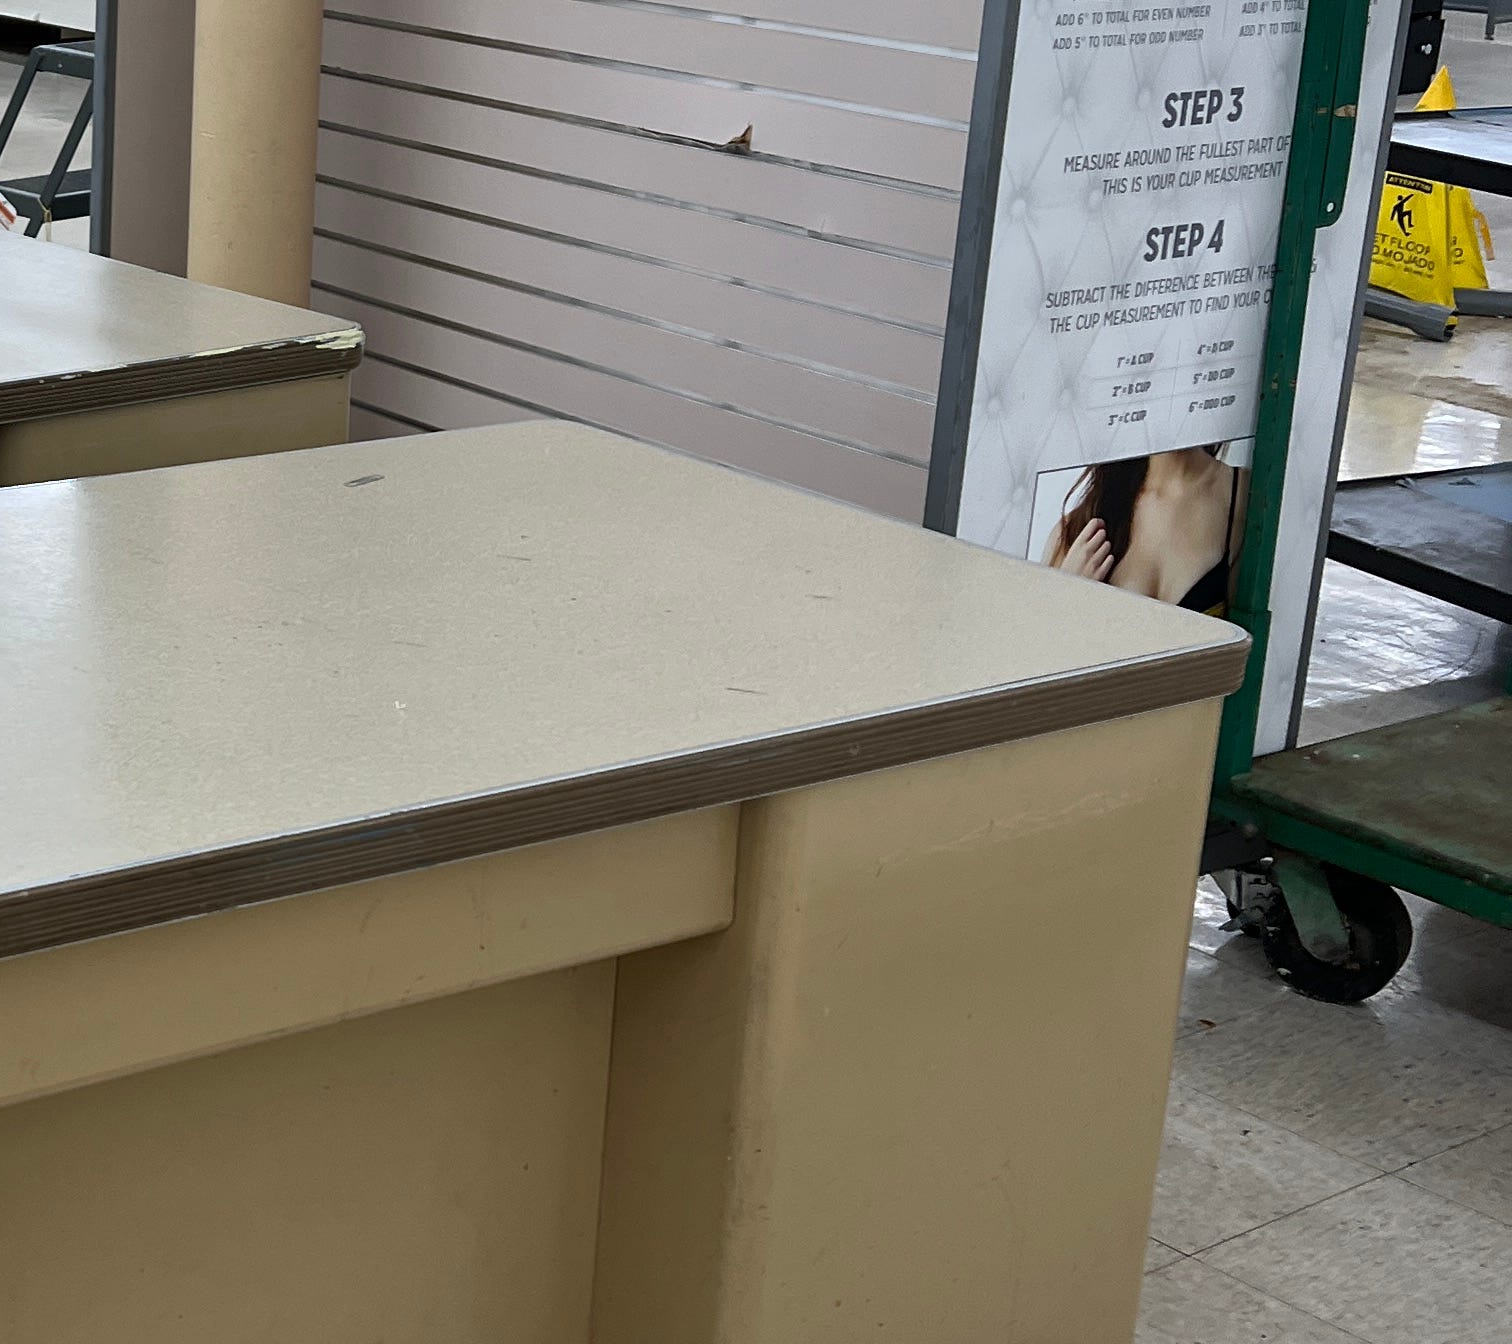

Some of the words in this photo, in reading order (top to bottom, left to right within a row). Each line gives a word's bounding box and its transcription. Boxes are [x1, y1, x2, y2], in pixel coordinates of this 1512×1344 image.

[1055, 14, 1075, 26] ADD
[1092, 12, 1103, 24] TO
[1106, 10, 1130, 23] TOTAL
[1133, 9, 1149, 22] FOR
[1152, 8, 1174, 21] EVEN
[1175, 5, 1211, 18] NUMBER
[1052, 37, 1072, 50] ADD
[1089, 35, 1100, 48] TO
[1103, 34, 1127, 47] TOTAL
[1130, 33, 1147, 45] FOR
[1149, 31, 1167, 44] ODD
[1169, 28, 1204, 43] NUMBER
[1162, 89, 1224, 128] STEP
[1227, 87, 1245, 122] 3
[1064, 151, 1121, 173] MEASURE
[1124, 147, 1172, 168] AROUND
[1176, 145, 1196, 162] THE
[1199, 139, 1245, 160] FULLEST
[1247, 136, 1274, 156] PART
[1102, 178, 1128, 197] THIS
[1131, 175, 1142, 193] IS
[1146, 173, 1175, 191] YOUR
[1179, 170, 1202, 188] CUP
[1203, 160, 1284, 185] MEASUREMENT
[1143, 222, 1205, 263] STEP
[1207, 219, 1225, 253] 4
[1045, 286, 1106, 309] SUBTRACT
[1110, 283, 1131, 300] THE
[1134, 273, 1199, 298] DIFFERENCE
[1203, 267, 1254, 288] BETWEEN
[1049, 315, 1071, 334] THE
[1076, 312, 1100, 331] CUP
[1103, 300, 1185, 327] MEASUREMENT
[1189, 298, 1203, 314] TO
[1205, 294, 1230, 313] FIND
[1233, 290, 1261, 308] YOUR
